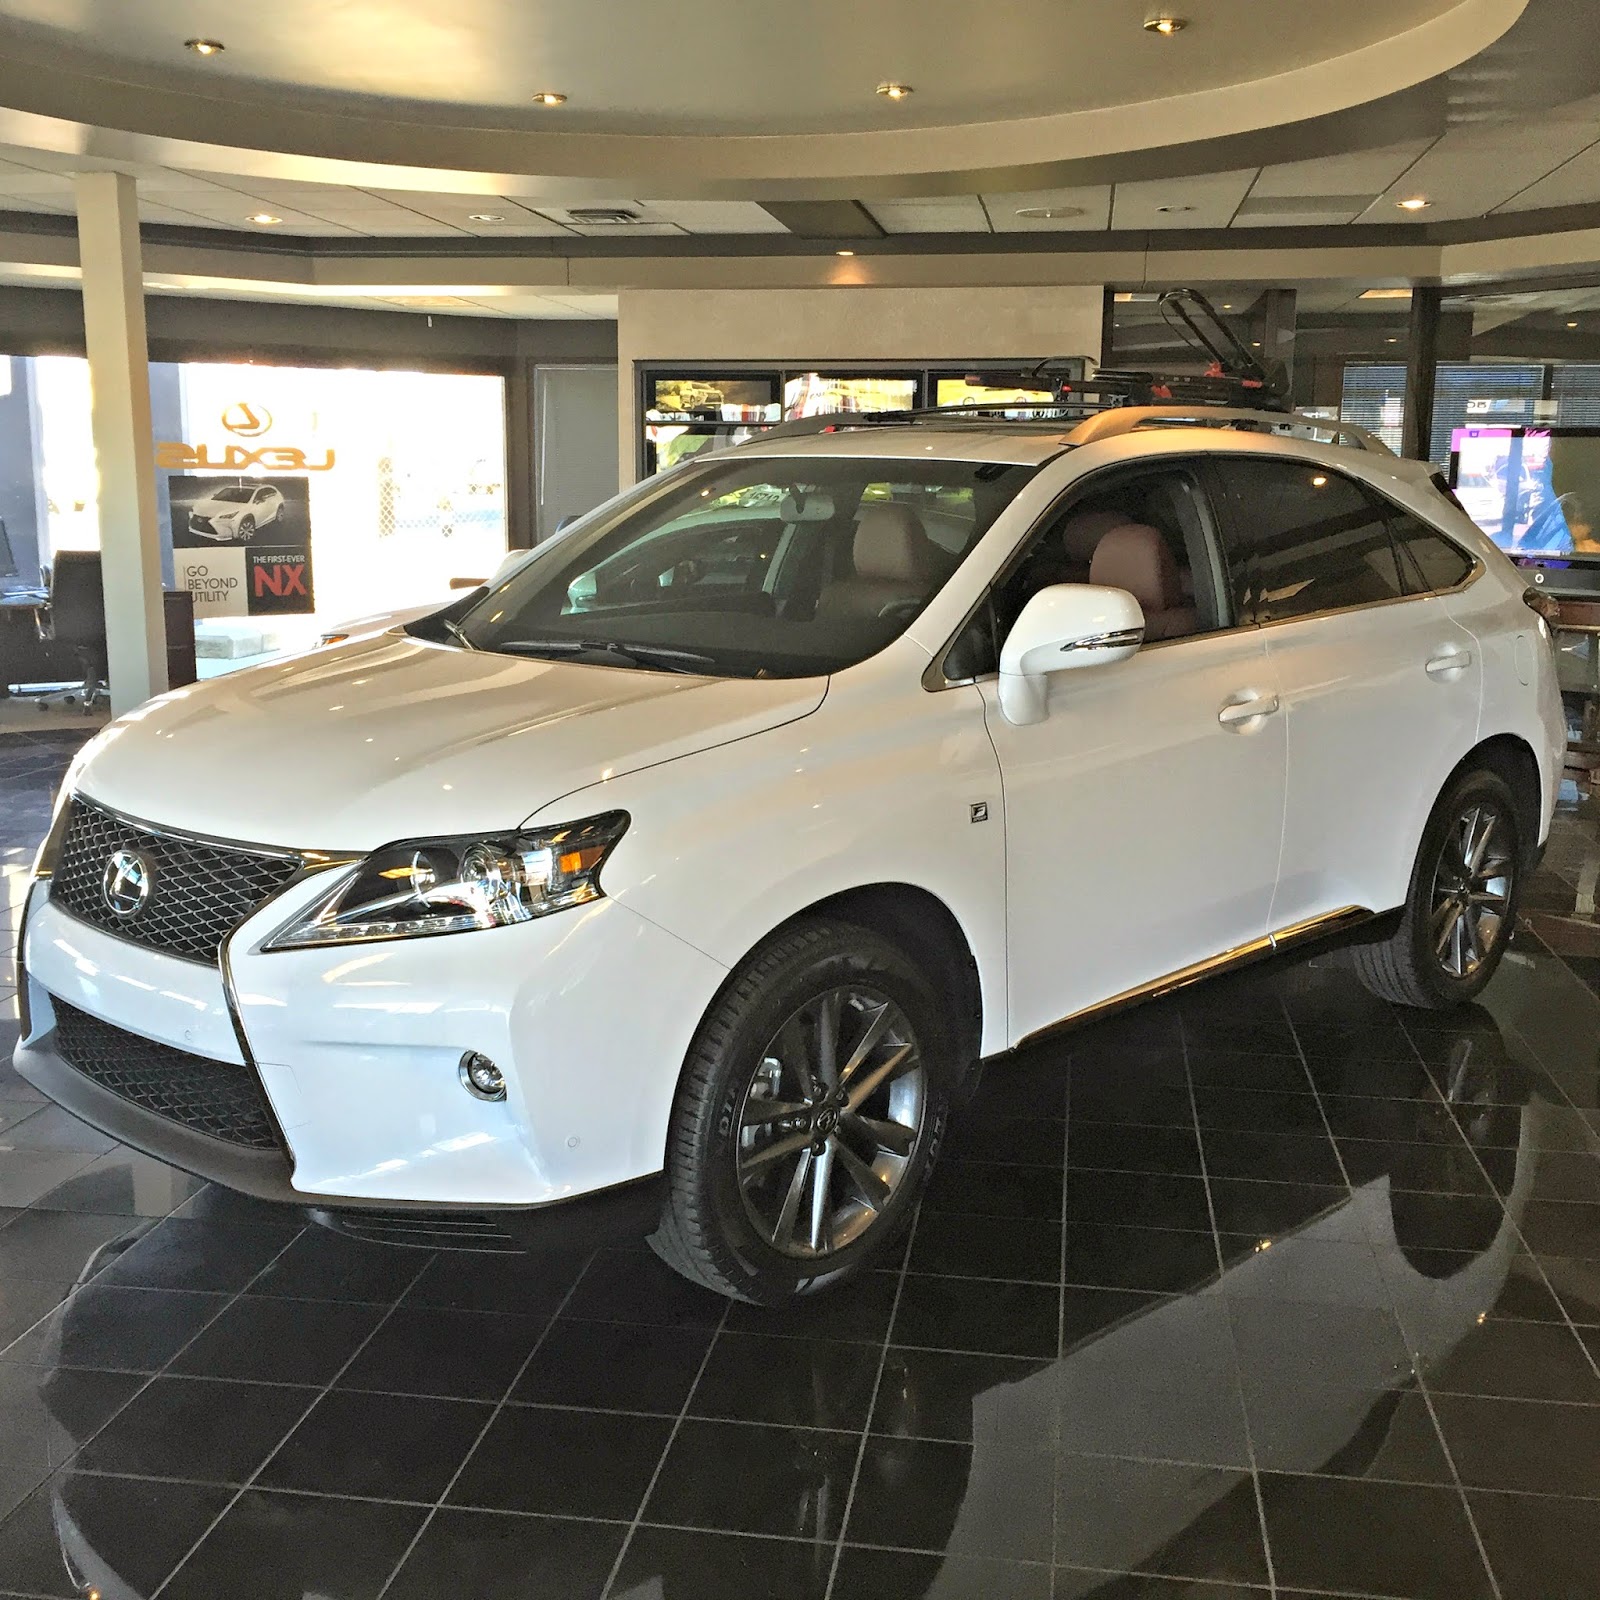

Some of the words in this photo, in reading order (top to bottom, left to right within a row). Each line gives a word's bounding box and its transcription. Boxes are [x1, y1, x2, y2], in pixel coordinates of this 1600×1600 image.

[268, 555, 305, 563] FIRST-EVER
[186, 565, 208, 577] GO
[187, 578, 238, 590] BEYOND
[254, 564, 307, 597] NX
